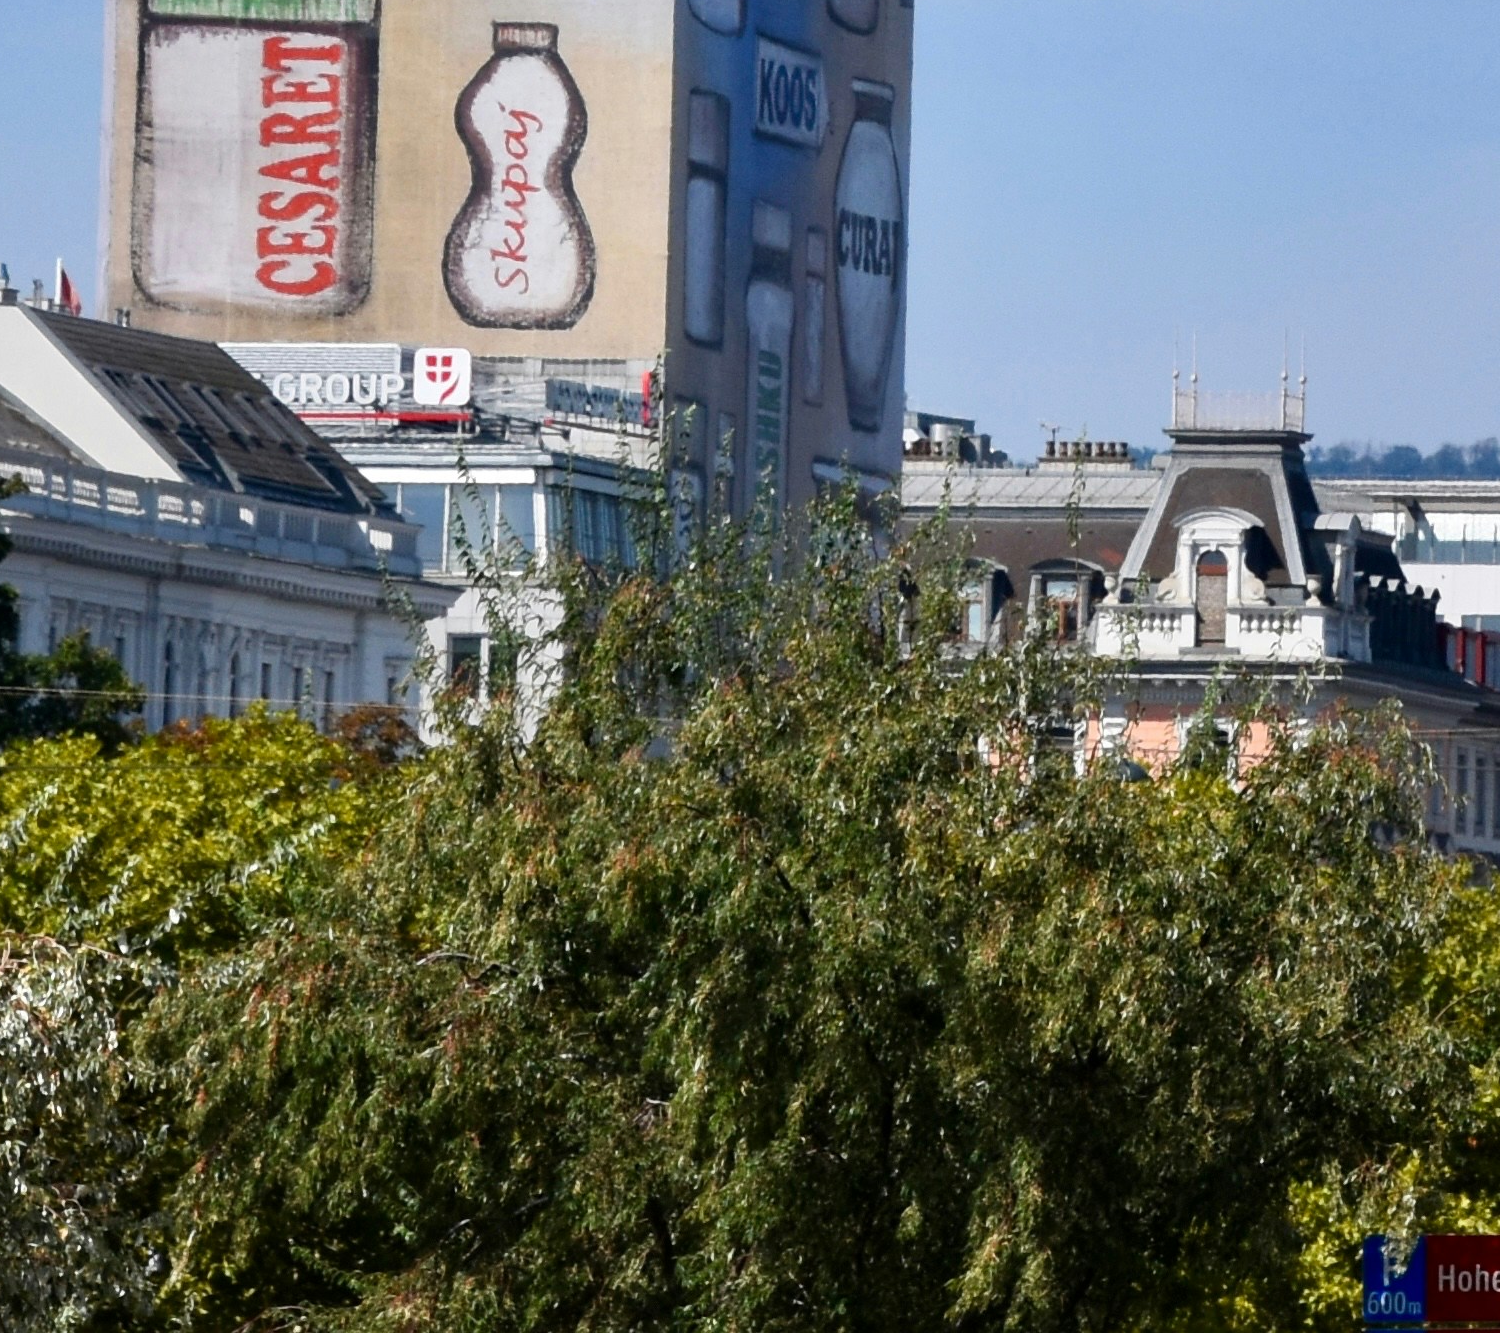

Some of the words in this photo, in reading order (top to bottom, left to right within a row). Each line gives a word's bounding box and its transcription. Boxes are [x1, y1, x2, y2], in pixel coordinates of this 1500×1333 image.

[758, 56, 818, 133] KOOS
[255, 35, 342, 296] CESARET
[489, 105, 543, 295] Skupaj
[270, 371, 405, 407] GROUP
